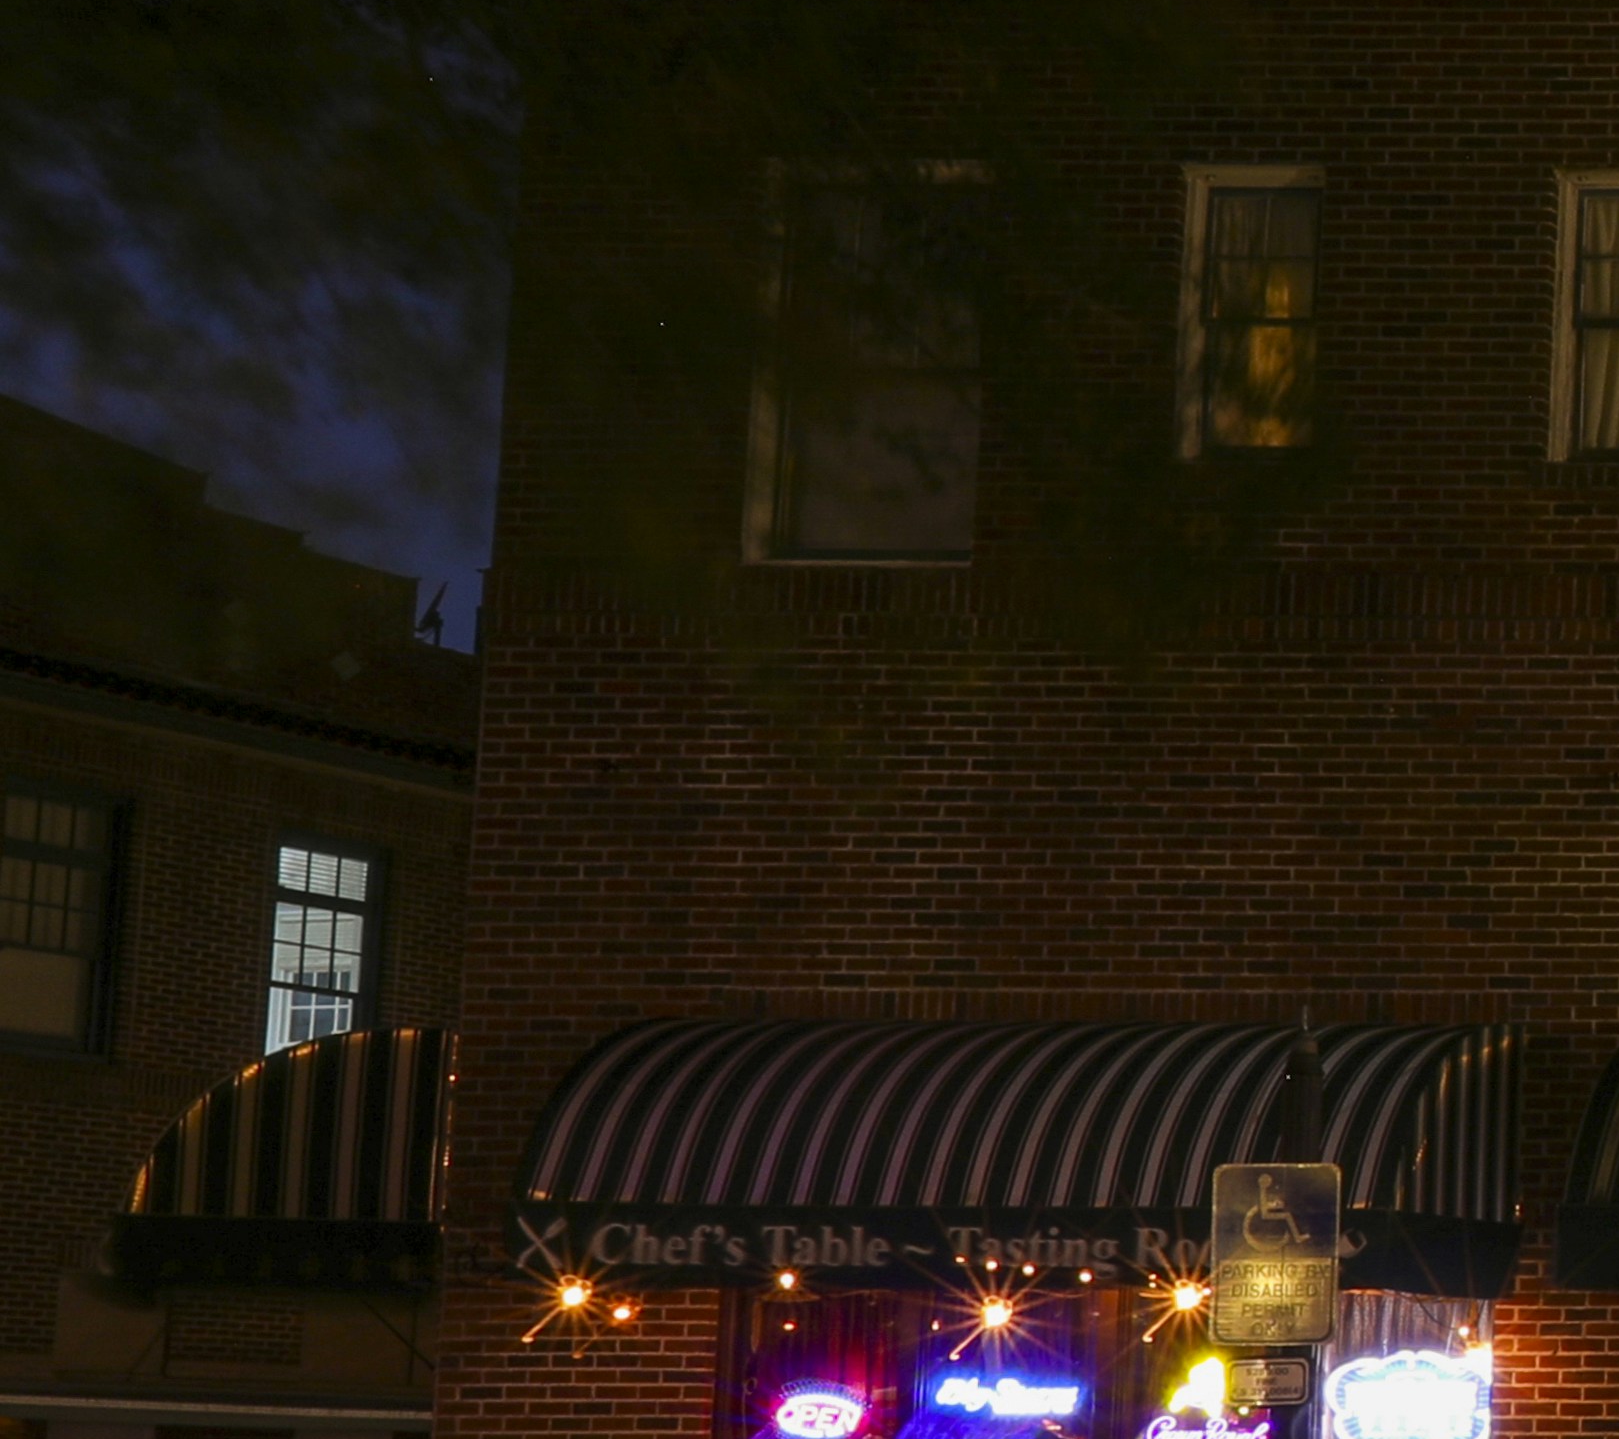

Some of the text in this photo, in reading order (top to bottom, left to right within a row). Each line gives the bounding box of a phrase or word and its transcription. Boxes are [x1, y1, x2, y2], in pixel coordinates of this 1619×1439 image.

[596, 1222, 748, 1265] Chef's
[761, 1224, 892, 1266] Table
[948, 1226, 1119, 1280] Tasting
[1135, 1226, 1213, 1265] Ro
[1221, 1263, 1331, 1279] PARKING BY
[1231, 1283, 1317, 1297] DISABLED
[1241, 1303, 1306, 1318] PERMIT
[777, 1397, 863, 1439] OPEN
